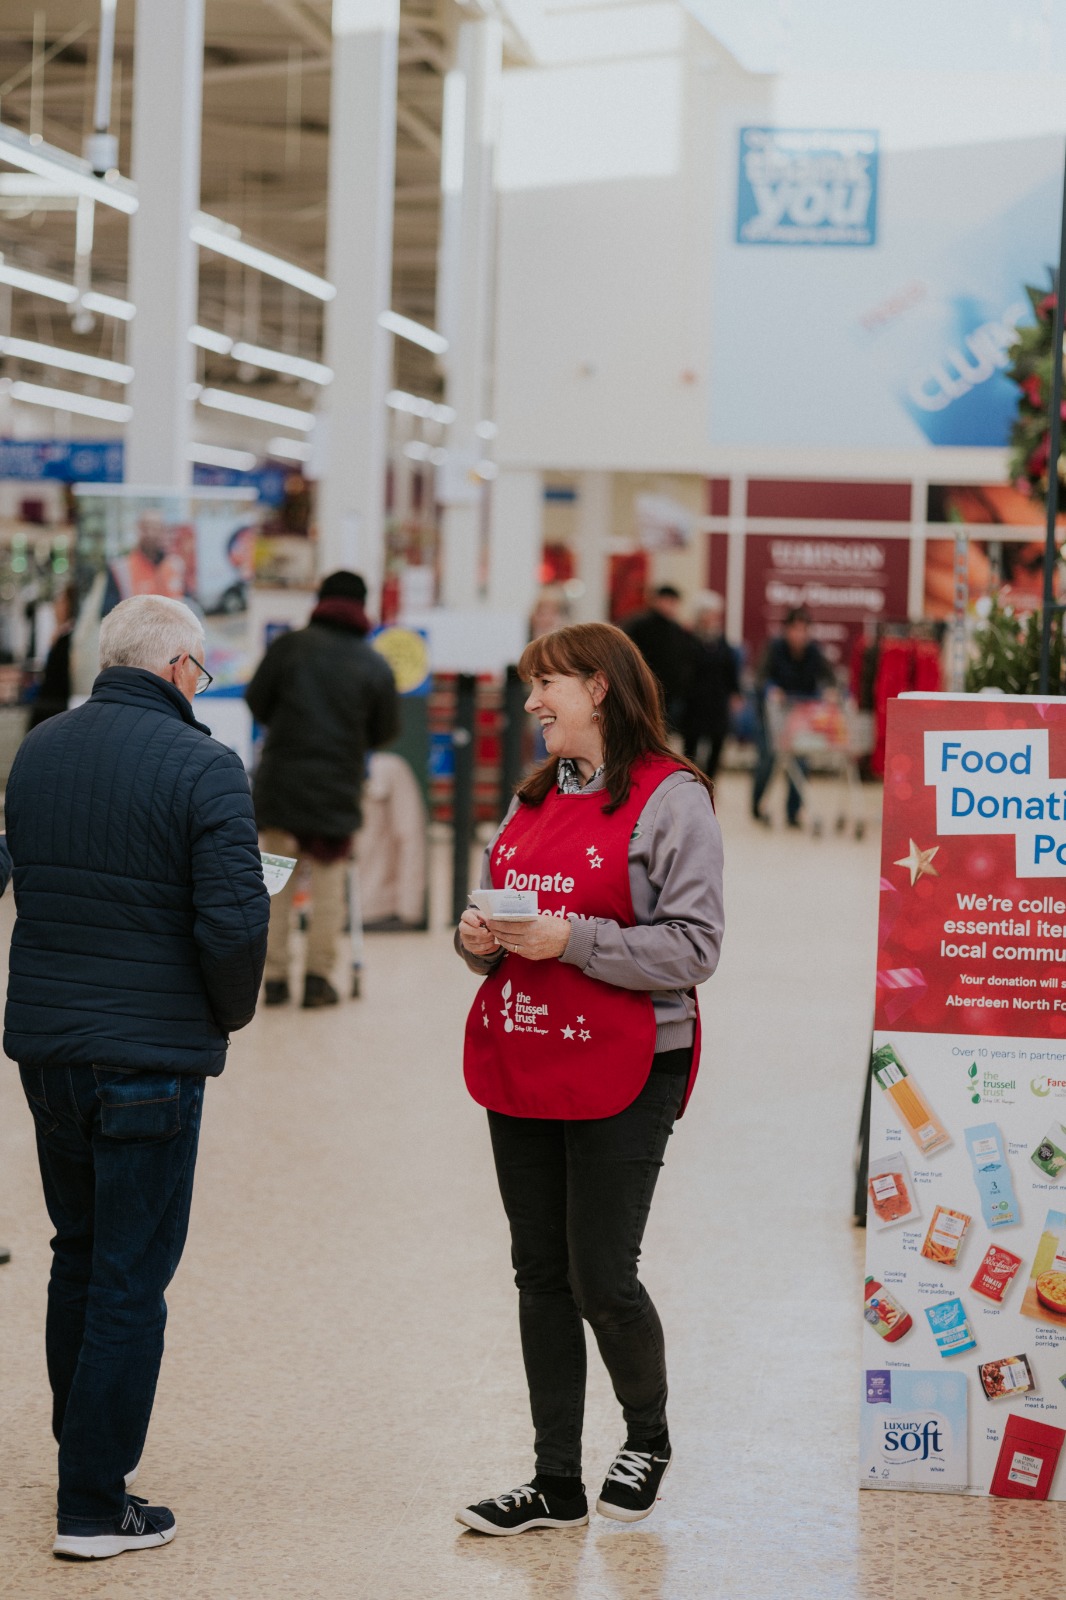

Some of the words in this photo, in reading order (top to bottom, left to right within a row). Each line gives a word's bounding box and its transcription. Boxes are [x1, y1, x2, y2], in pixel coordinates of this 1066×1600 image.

[941, 742, 1032, 775] Food
[504, 869, 575, 894] Donate
[1018, 896, 1066, 914] colle
[943, 918, 1030, 937] essential
[940, 939, 987, 958] local
[992, 945, 1066, 962] commu
[960, 973, 985, 985] Your
[987, 974, 1037, 988] donation
[1039, 977, 1058, 989] will
[516, 992, 531, 1004] the
[945, 995, 1009, 1009] Aberdeen
[1012, 997, 1050, 1010] North
[515, 1003, 549, 1016] trussell
[514, 1012, 537, 1025] trust
[951, 1046, 975, 1057] Over
[978, 1048, 988, 1058] 10
[990, 1049, 1016, 1060] years
[1018, 1050, 1027, 1059] in
[983, 1071, 999, 1081] the
[983, 1080, 1016, 1090] trussell
[983, 1088, 1004, 1097] trust
[990, 1181, 998, 1191] 3
[884, 1270, 907, 1278] Cooking
[918, 1281, 938, 1289] Sponge
[982, 1274, 1002, 1289] TOMATO
[982, 1282, 997, 1291] SOUP
[930, 1288, 956, 1296] puddings
[883, 1421, 921, 1432] Luxury
[884, 1420, 943, 1460] soft
[986, 1434, 999, 1442] bags
